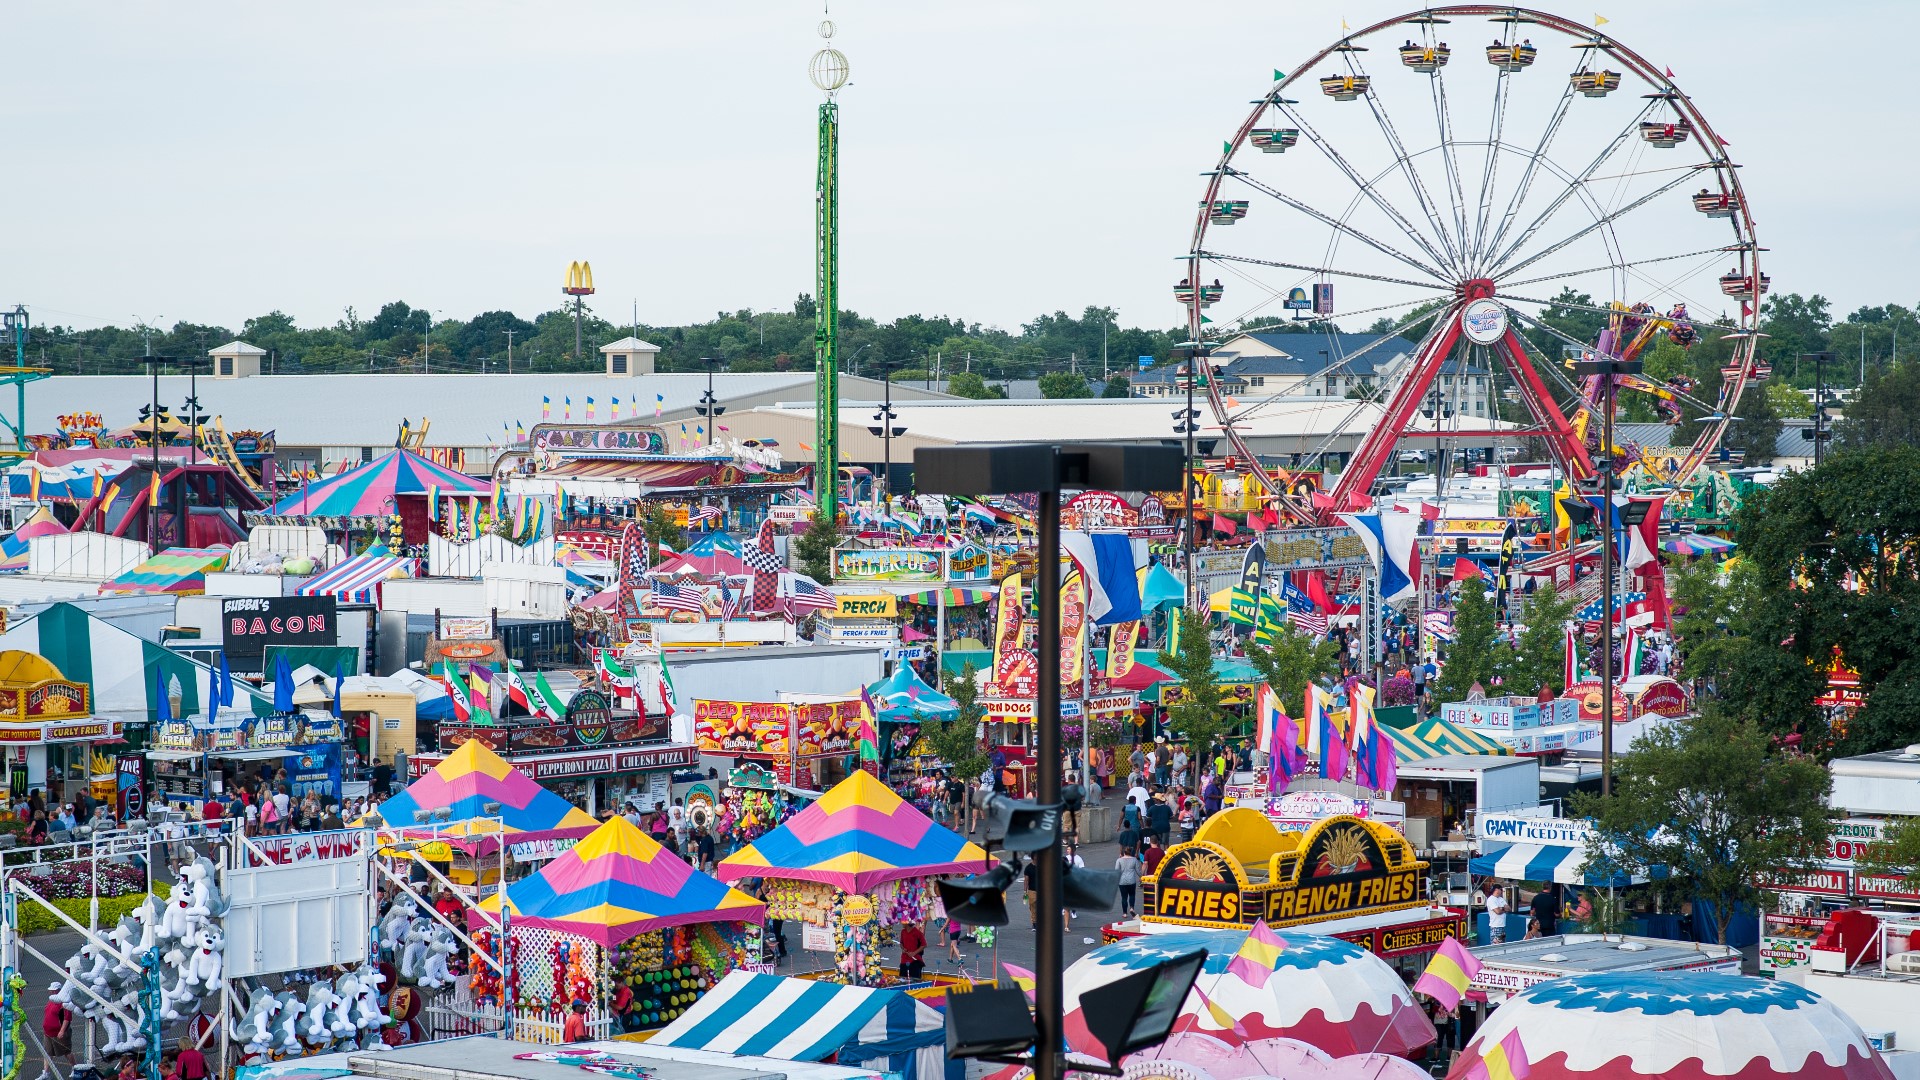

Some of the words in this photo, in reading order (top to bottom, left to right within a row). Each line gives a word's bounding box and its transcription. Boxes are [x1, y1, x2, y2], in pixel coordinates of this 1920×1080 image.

[549, 430, 599, 449] MARDI
[604, 431, 648, 449] GRAS
[1073, 499, 1124, 517] PIZZA
[1142, 501, 1164, 520] PIZZA
[1150, 528, 1174, 536] PIZZA
[907, 552, 930, 572] UP
[976, 554, 987, 566] UP
[224, 599, 270, 614] BUBBA'S
[842, 601, 888, 615] PERCH
[1003, 584, 1019, 633] CORN
[1062, 583, 1080, 628] CORN
[232, 615, 326, 635] BACON
[898, 649, 921, 660] FRIES
[1061, 636, 1077, 682] DOGS
[1114, 631, 1132, 676] DOGS
[1001, 652, 1023, 674] PRONTO
[29, 688, 45, 709] FRY
[45, 684, 82, 704] MASTERS
[1088, 698, 1112, 711] RONTO
[1112, 696, 1131, 707] DOGS
[697, 703, 738, 719] DEEP
[742, 705, 787, 722] FRIED
[799, 705, 834, 724] DEEP
[983, 702, 1003, 713] ORN
[1004, 702, 1032, 713] DOGS
[1062, 708, 1080, 716] WATER
[268, 720, 284, 731] ICE
[576, 711, 606, 726] PIZZA
[53, 727, 78, 737] CURLY
[80, 725, 102, 735] FRIES
[169, 723, 185, 734] ICE
[162, 735, 192, 747] CREAM
[258, 732, 293, 744] CREAM
[537, 760, 585, 776] PEPPERONI
[586, 758, 609, 771] PIZZA
[622, 753, 657, 768] CHEESE
[659, 751, 684, 764] PIZZA
[1294, 796, 1319, 804] Fresh
[1273, 803, 1321, 814] COTTON
[1324, 803, 1363, 815] CANDY
[1486, 819, 1527, 836] GIANT
[1555, 822, 1587, 830] BREWED
[1526, 827, 1557, 839] ICED
[1559, 830, 1588, 842] TEA
[250, 838, 293, 868] ONE
[295, 841, 312, 861] IN
[535, 839, 555, 854] LIVE
[1160, 888, 1238, 919] FRIES
[1268, 882, 1353, 920] FRENCH
[1357, 873, 1416, 907] FRIES
[1383, 931, 1424, 950] CHEESE
[1426, 924, 1455, 944] FRIES
[1762, 949, 1805, 961] STROMBOLI
